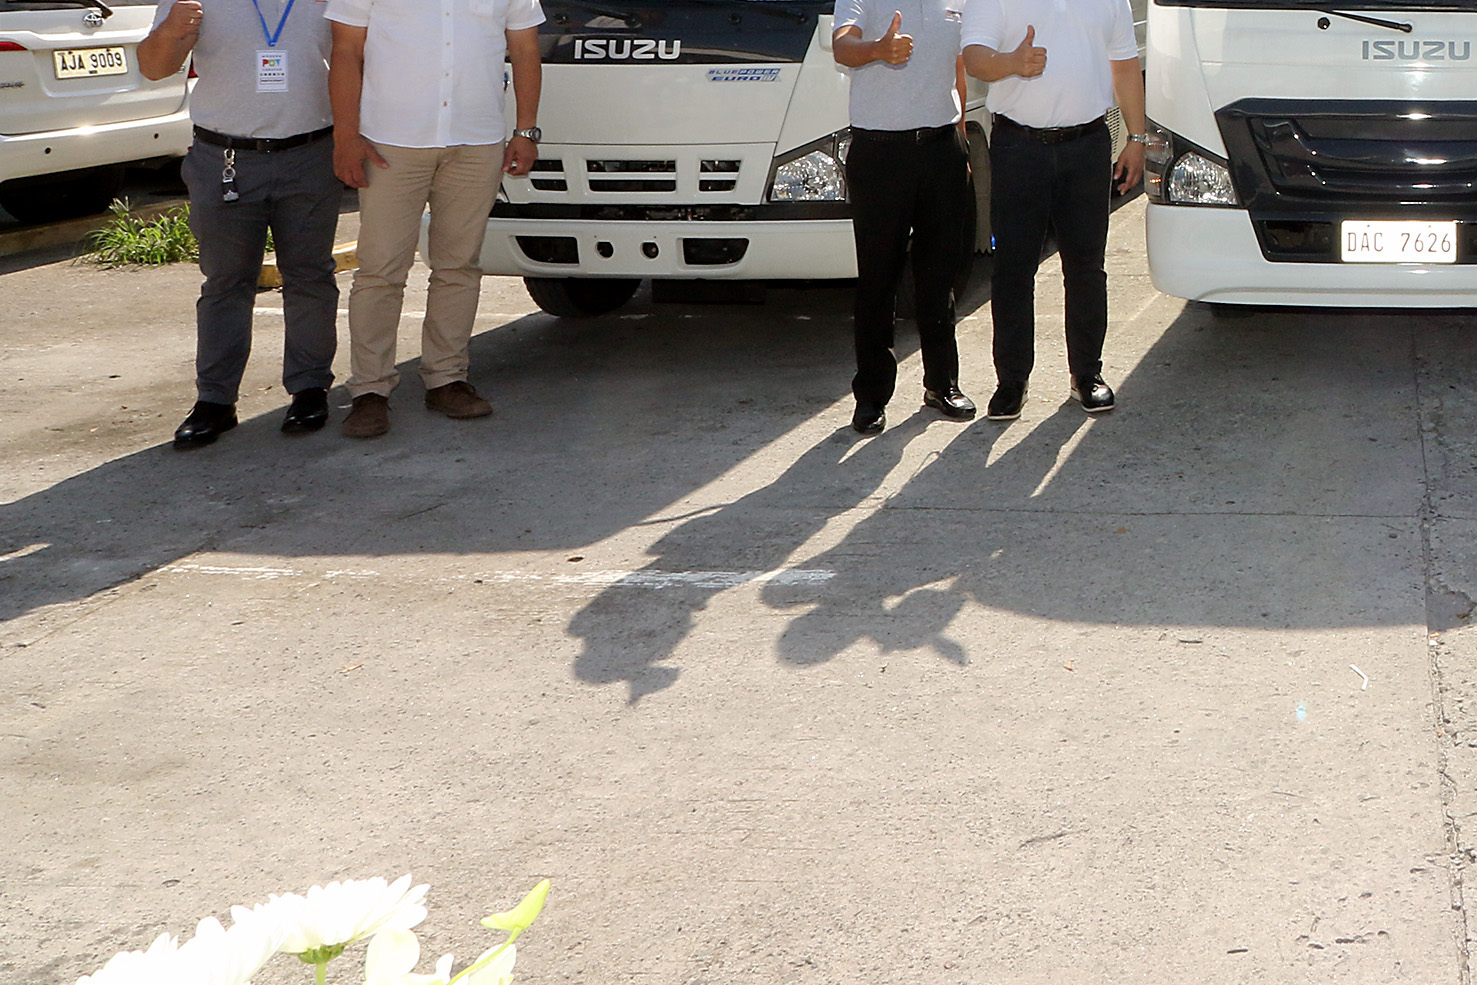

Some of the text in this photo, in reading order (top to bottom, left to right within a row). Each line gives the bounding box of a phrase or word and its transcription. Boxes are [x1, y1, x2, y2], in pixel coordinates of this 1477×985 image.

[574, 39, 681, 60] ISUZU
[1362, 40, 1471, 61] ISUZU
[61, 52, 123, 71] AJA 9009
[1347, 232, 1451, 253] DAC 7626
